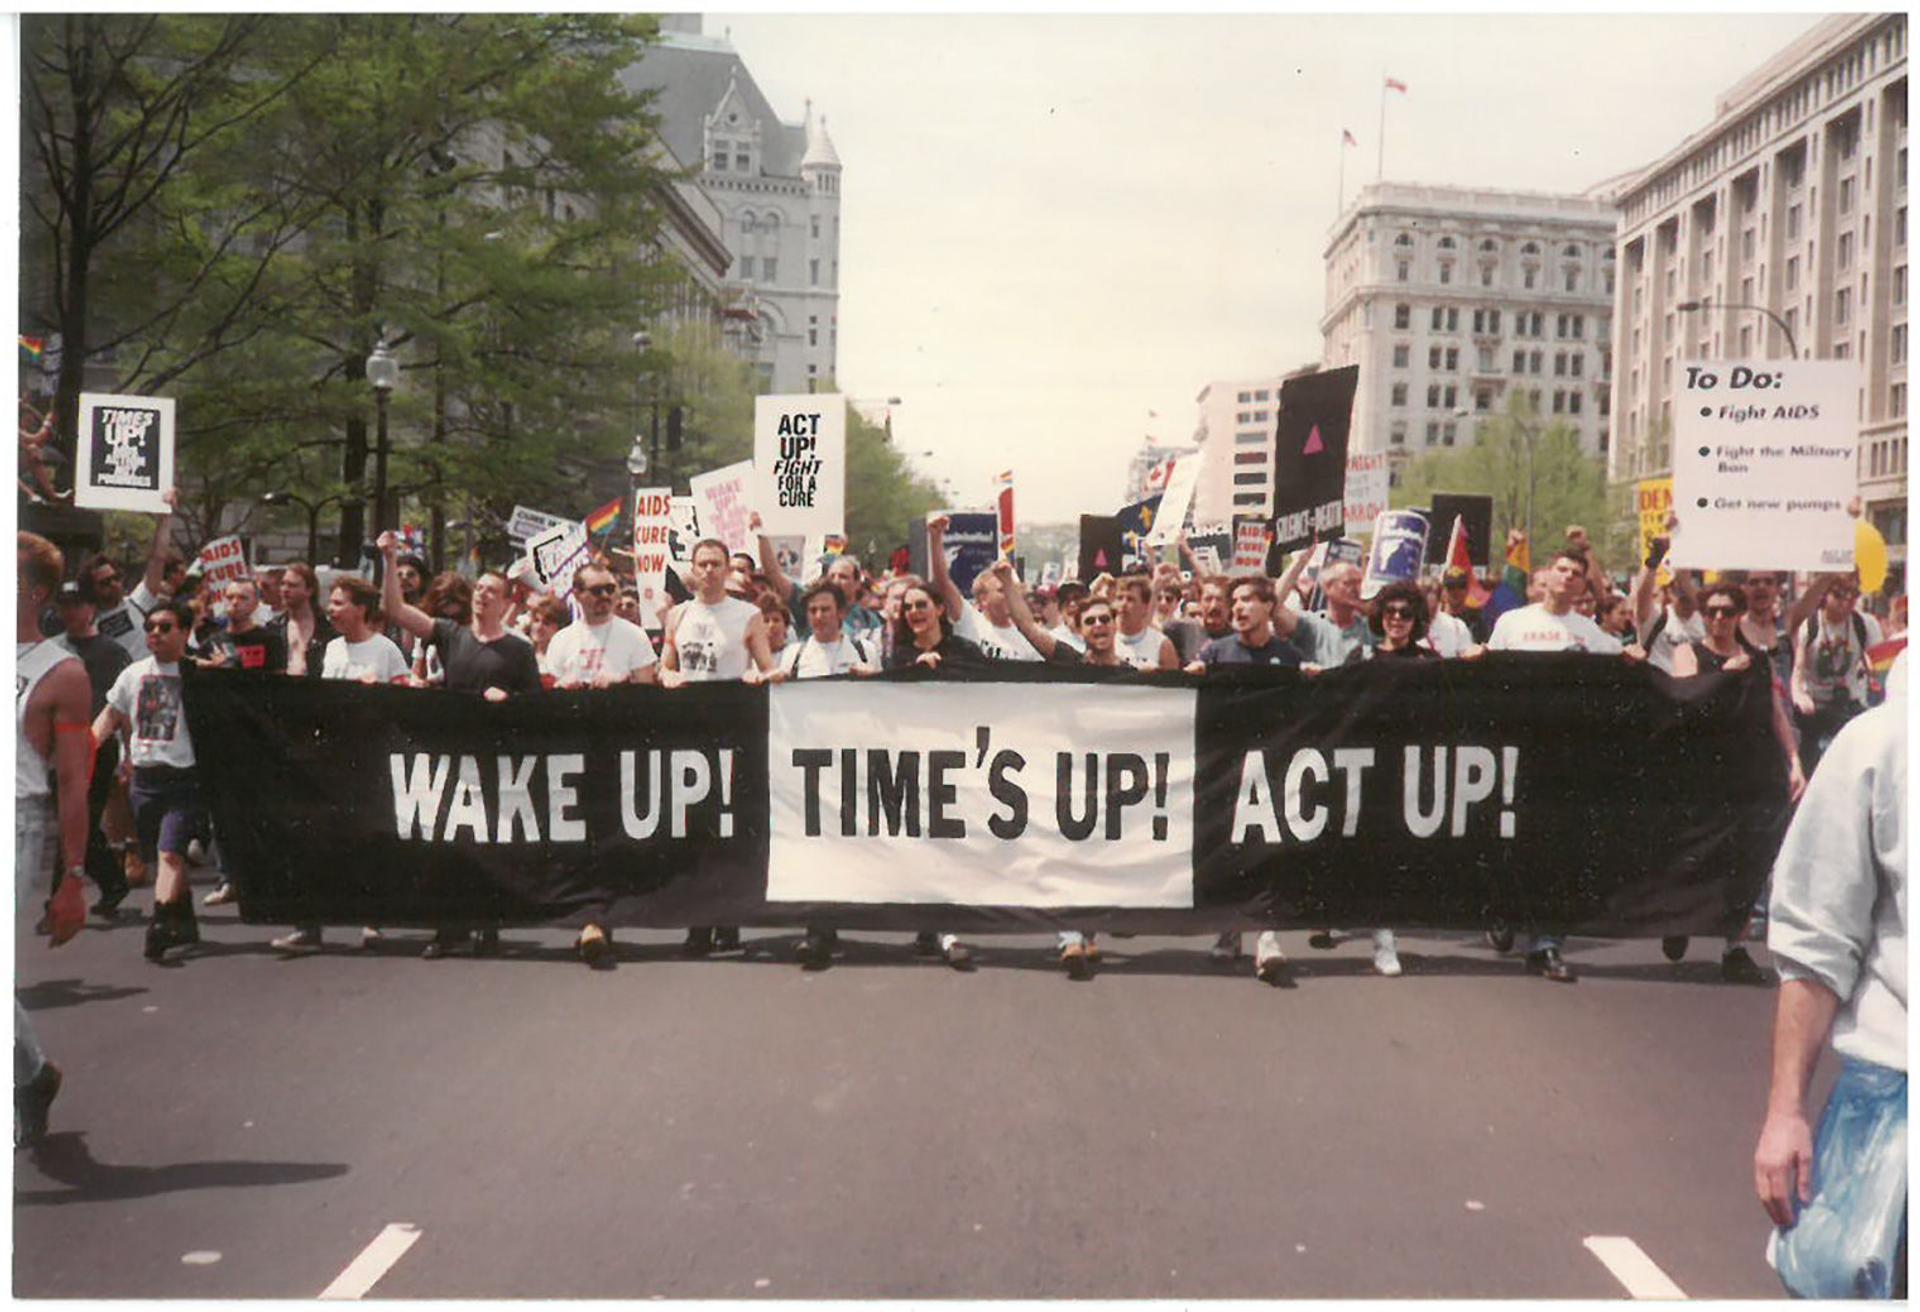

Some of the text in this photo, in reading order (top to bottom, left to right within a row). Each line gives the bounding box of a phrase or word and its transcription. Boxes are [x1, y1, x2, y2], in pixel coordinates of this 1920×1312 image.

[1687, 366, 1783, 390] To Do:
[1719, 405, 1820, 423] Fight AIDS
[778, 414, 821, 436] ACT
[105, 423, 146, 447] UP!
[780, 436, 817, 460] UP!
[1717, 445, 1852, 459] Fight the Military
[773, 459, 824, 476] FIGHT
[1718, 462, 1748, 473] Ban
[778, 475, 817, 491] FOR A
[637, 495, 671, 516] AIDS
[779, 491, 816, 508] CURE
[1714, 498, 1742, 509] Get
[1786, 500, 1841, 512] pumps
[635, 526, 668, 544] CURE
[202, 540, 241, 562] AIDS
[637, 554, 665, 574] NOW
[389, 726, 1520, 844] WAKE UP! TIME'S UP! ACT UP!
